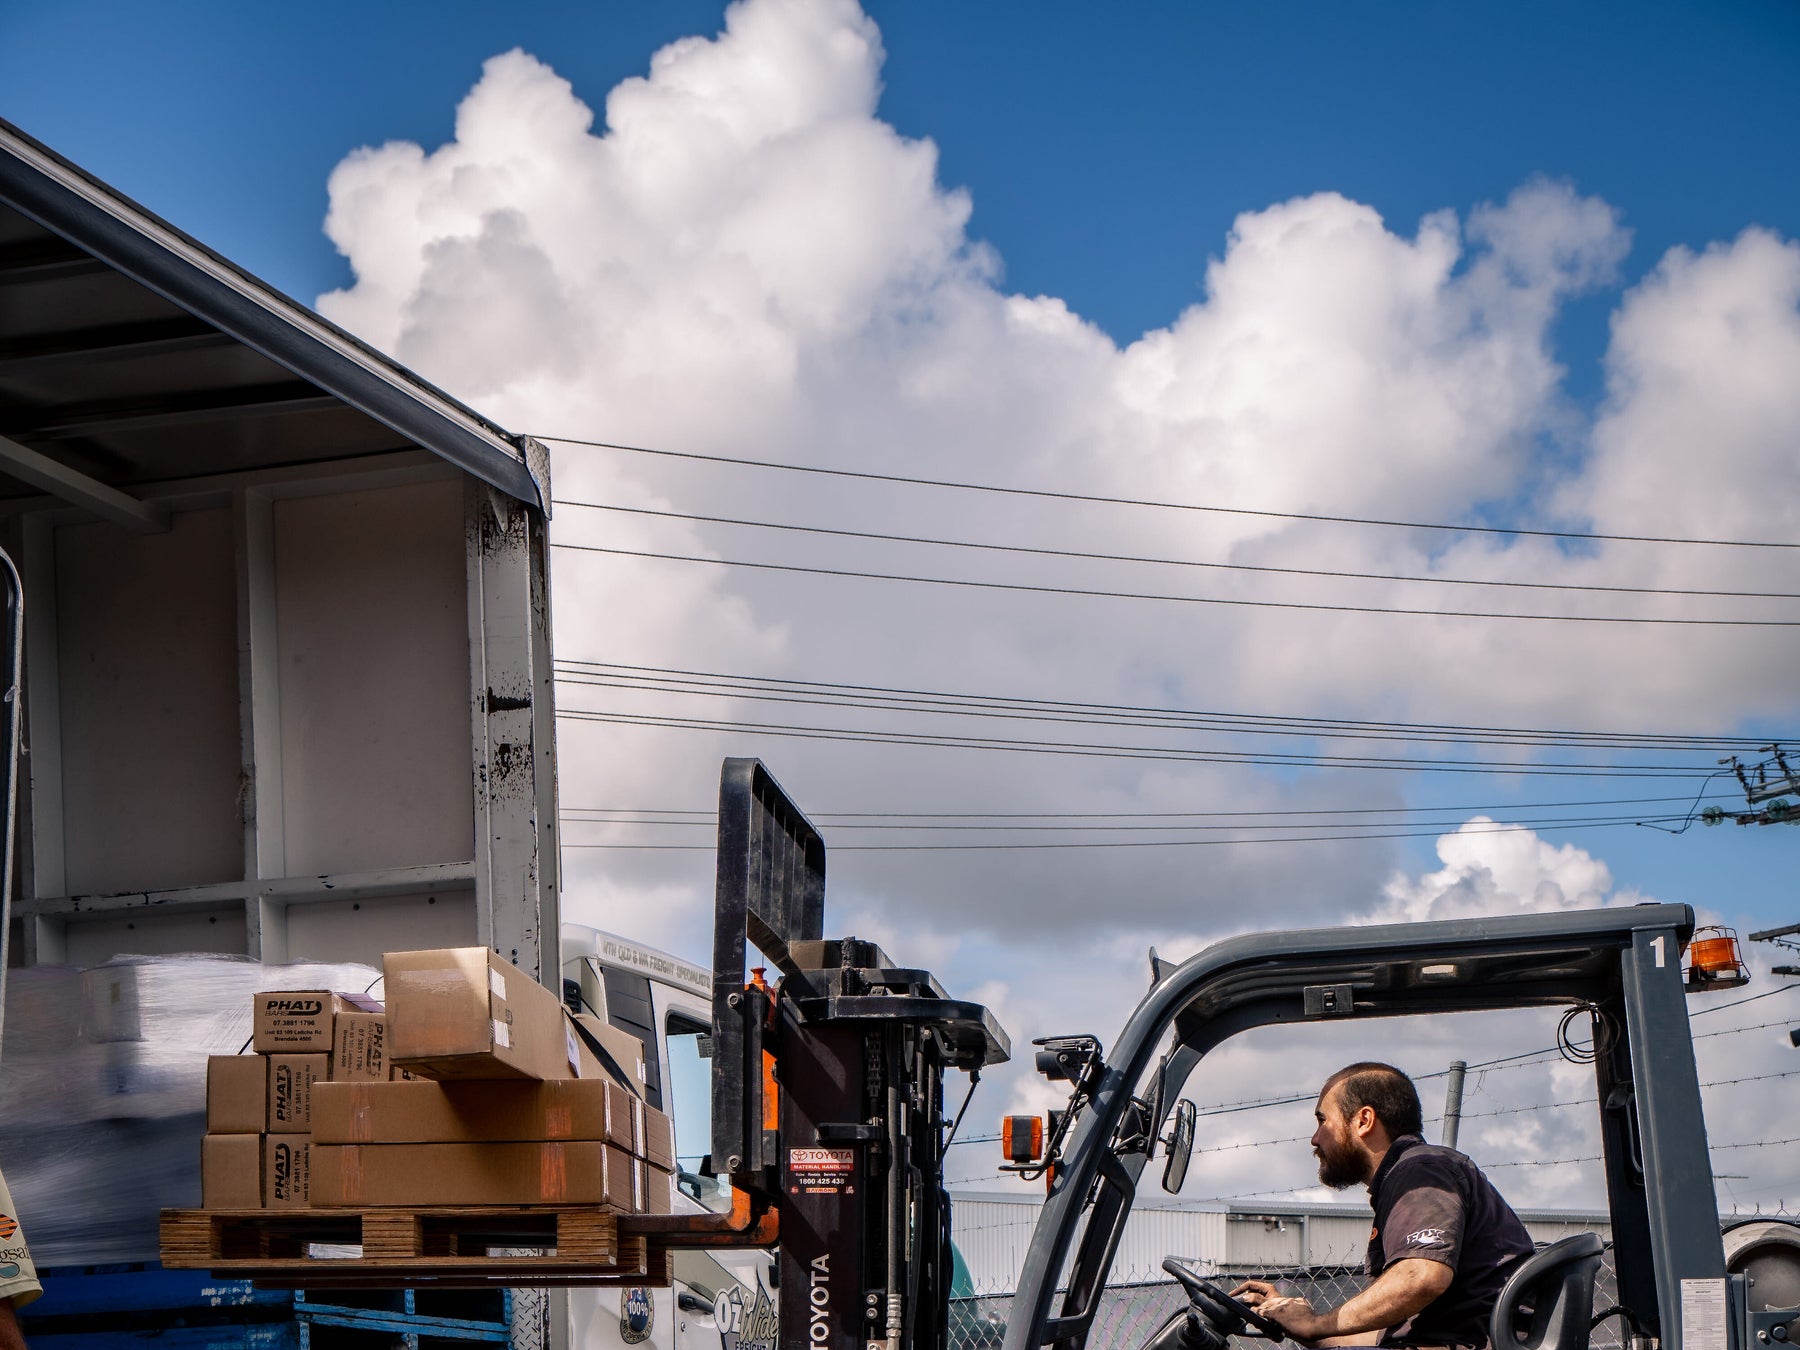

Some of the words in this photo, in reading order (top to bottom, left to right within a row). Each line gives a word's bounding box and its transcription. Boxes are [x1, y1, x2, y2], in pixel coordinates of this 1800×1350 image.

[618, 945, 632, 962] QLD
[649, 955, 675, 976] FREIGHT
[1650, 936, 1665, 967] 1
[266, 1001, 314, 1010] PHAT
[372, 1022, 384, 1071] PHAT
[277, 1072, 286, 1121] PHAT
[295, 1106, 301, 1115] 07
[809, 1151, 853, 1160] TOYOTA
[275, 1151, 284, 1199] PHAT
[294, 1185, 300, 1193] 07
[628, 1300, 649, 1317] 100%
[739, 1295, 779, 1343] Wide
